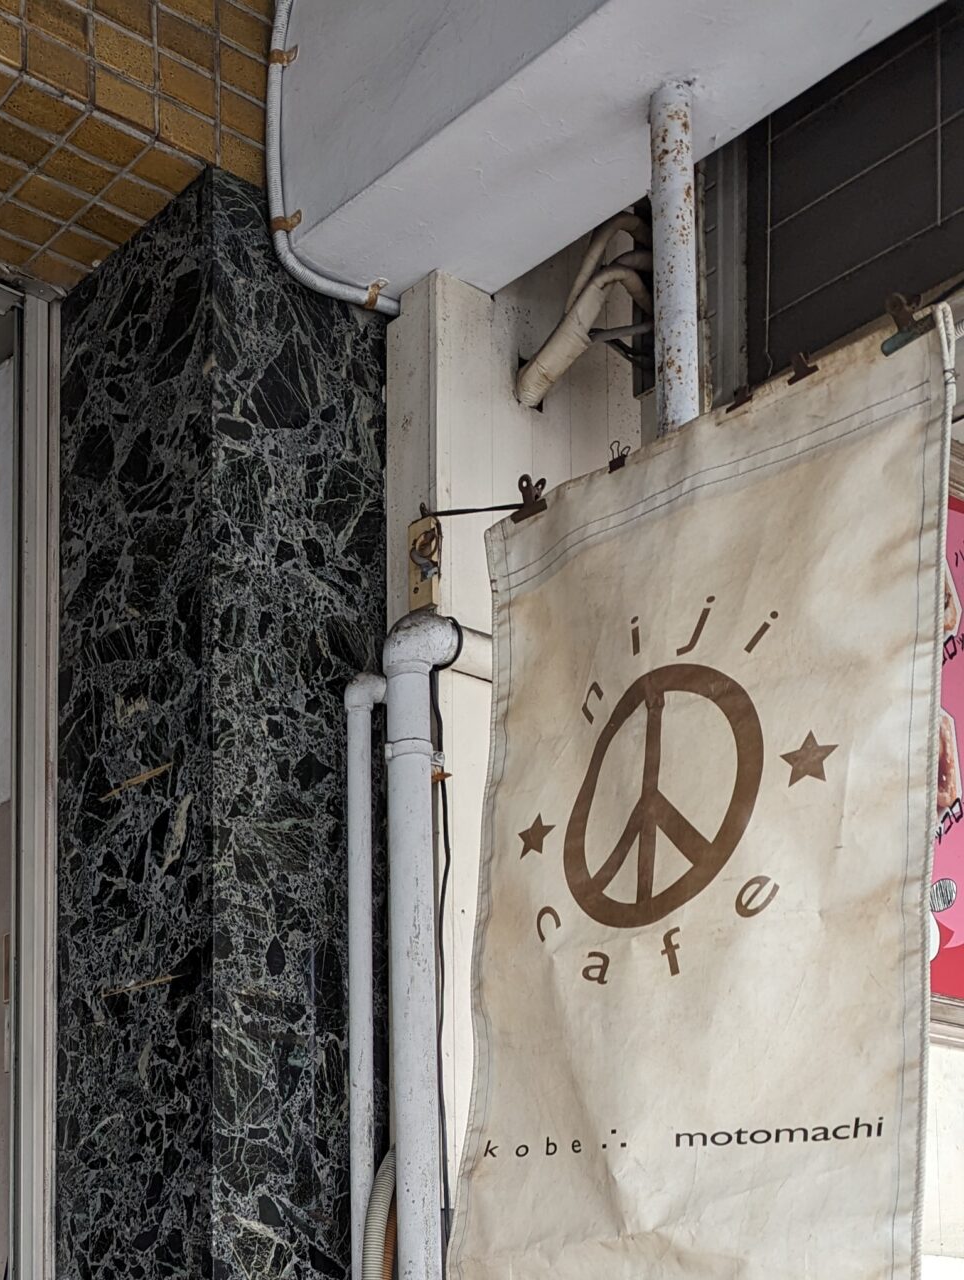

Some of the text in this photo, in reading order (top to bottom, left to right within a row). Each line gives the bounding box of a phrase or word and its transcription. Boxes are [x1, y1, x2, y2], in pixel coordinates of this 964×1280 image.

[582, 595, 779, 725] niji
[536, 874, 780, 985] cafe
[483, 1117, 883, 1159] kobe motomachi
